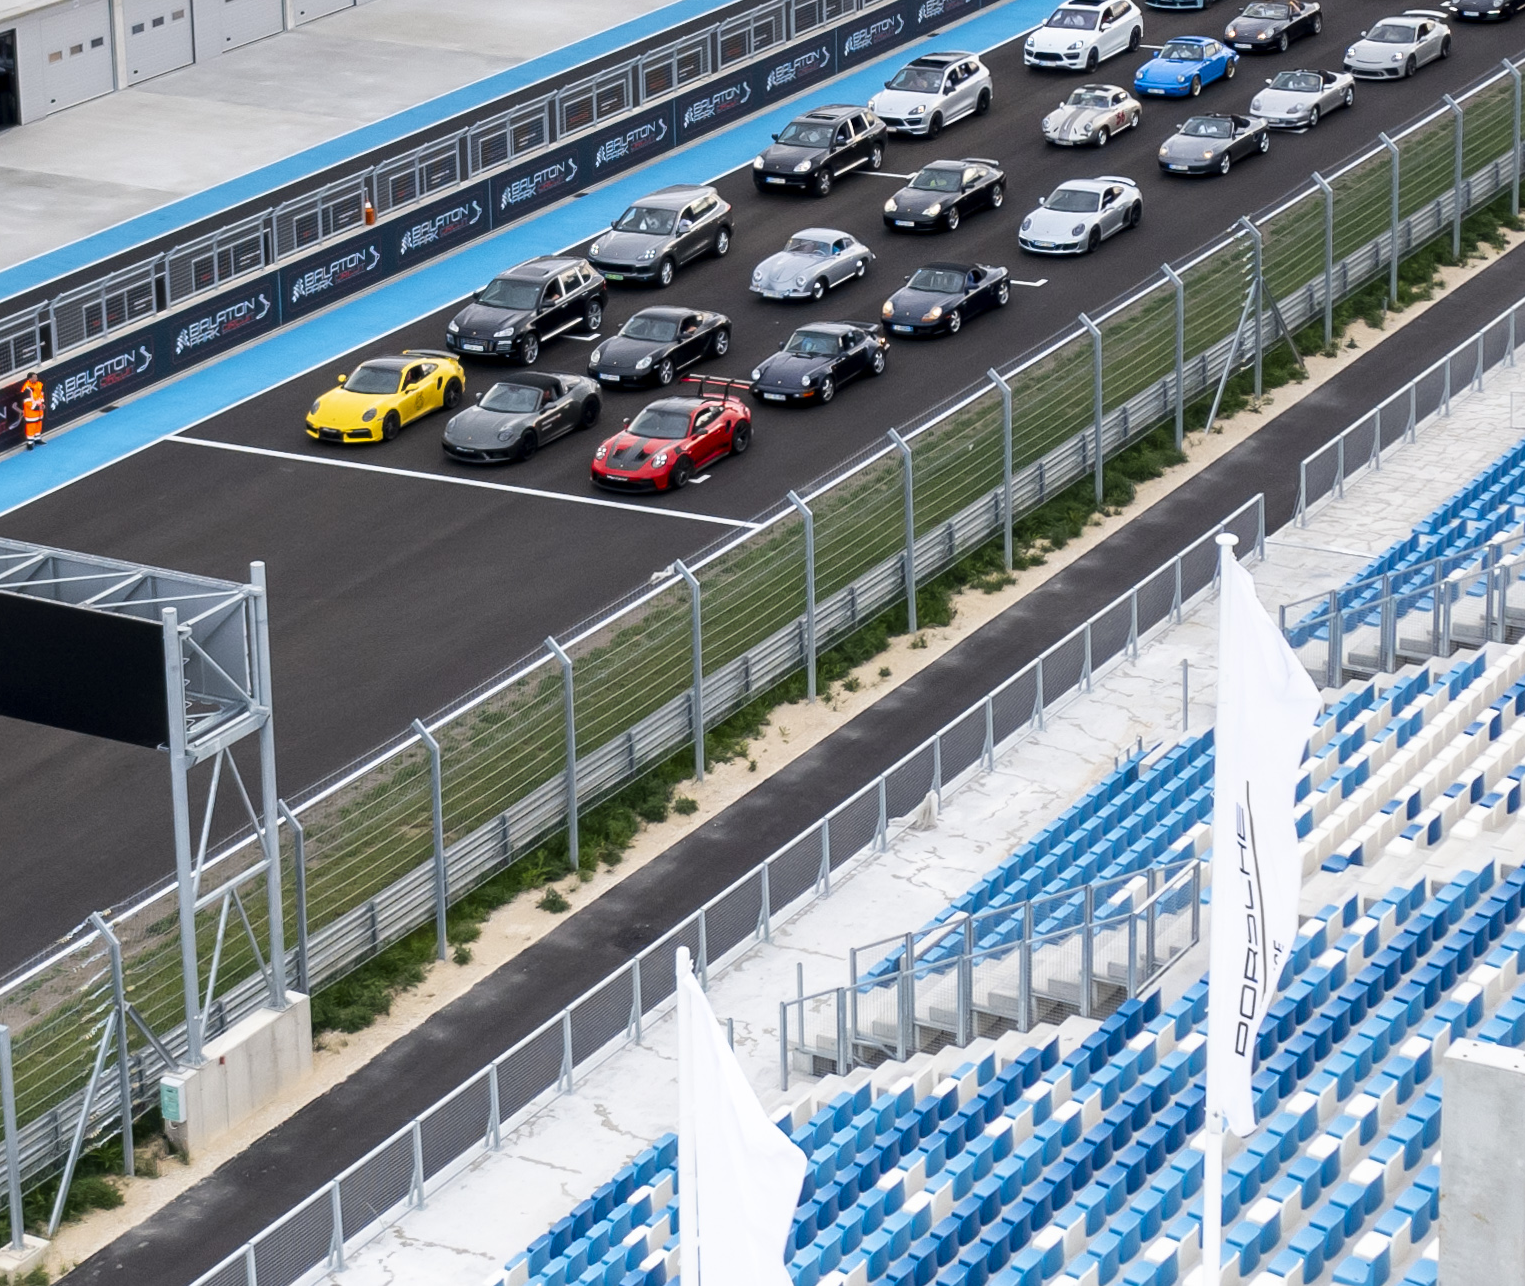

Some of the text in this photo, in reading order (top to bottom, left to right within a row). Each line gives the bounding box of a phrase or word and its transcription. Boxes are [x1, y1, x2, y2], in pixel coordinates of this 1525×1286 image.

[853, 15, 896, 45] BALATON
[776, 49, 820, 80] BALATON
[693, 83, 741, 115] BALATON
[605, 120, 656, 154] BALATON
[606, 144, 630, 162] PARK
[511, 160, 565, 196] BALATON
[512, 185, 537, 205] PARK
[412, 203, 469, 239] BALATON
[412, 230, 439, 250] PARK
[304, 249, 366, 287] BALATON
[305, 276, 334, 297] PARK
[189, 297, 256, 339] BALATON
[189, 313, 255, 348] PARK CIRCUIT
[65, 349, 136, 392] BALATON
[66, 365, 135, 404] PARK CIRCUIT
